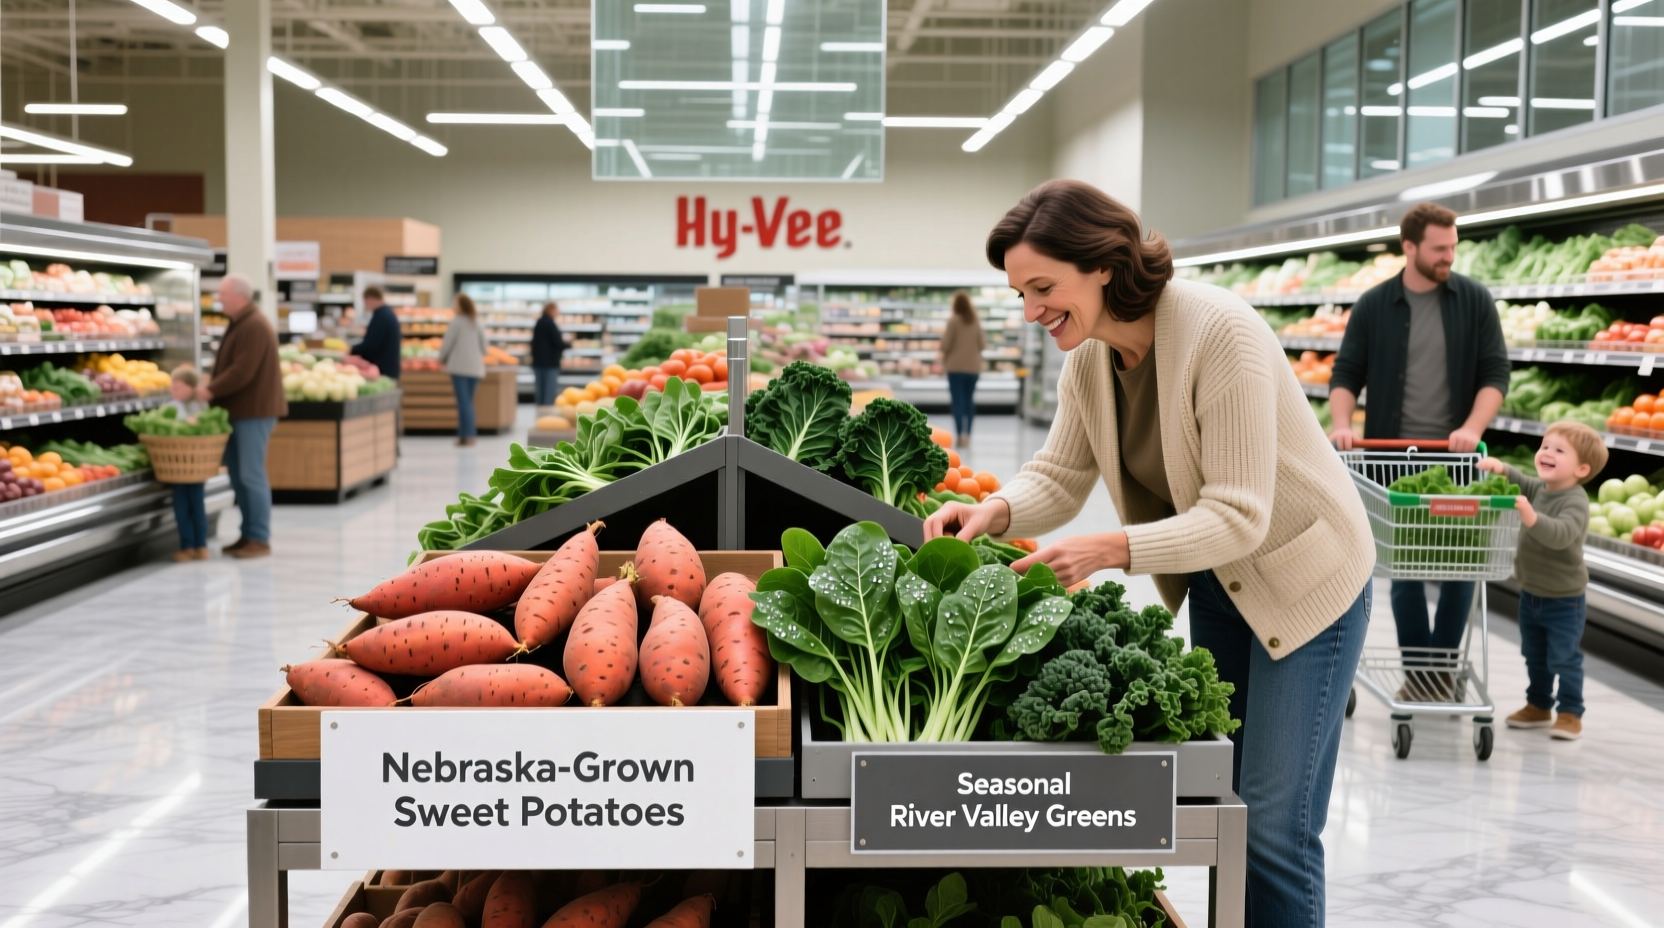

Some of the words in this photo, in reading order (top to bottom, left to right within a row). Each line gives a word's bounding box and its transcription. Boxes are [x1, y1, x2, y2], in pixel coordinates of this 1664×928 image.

[382, 750, 694, 783] Nebraska-Grown
[956, 771, 1071, 795] Seasonal
[393, 795, 510, 827] Sweet
[521, 795, 685, 827] Potatoes
[890, 802, 957, 828] River
[962, 803, 1040, 833] Valley
[1045, 803, 1137, 828] Greens
